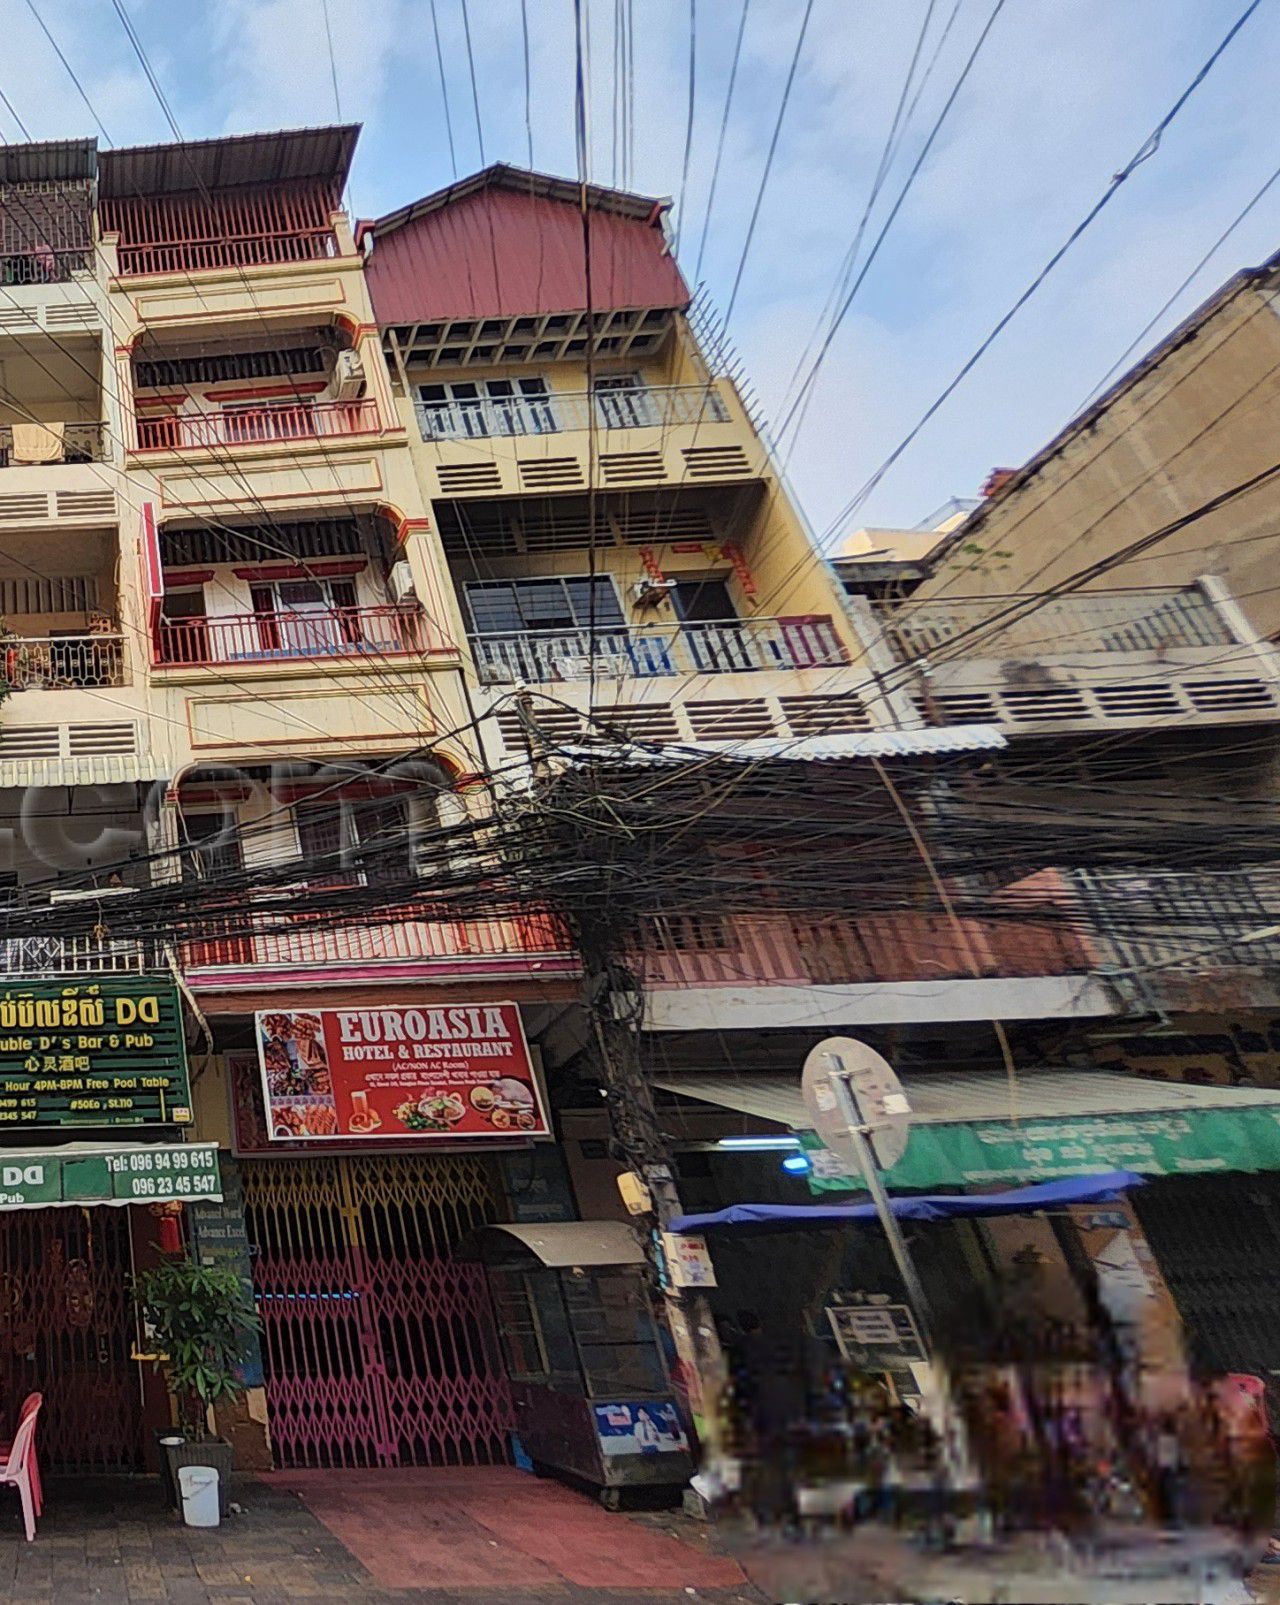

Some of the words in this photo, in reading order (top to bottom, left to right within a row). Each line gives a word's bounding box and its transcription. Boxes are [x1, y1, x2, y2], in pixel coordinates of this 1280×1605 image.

[336, 1008, 511, 1043] EUROASIA
[78, 1035, 102, 1049] Bar
[109, 1034, 120, 1048] &
[125, 1033, 154, 1048] Pub
[342, 1045, 394, 1061] HOTEL
[397, 1044, 411, 1060] &
[414, 1042, 513, 1059] RESTAURANT
[24, 1055, 90, 1073] 心灵酒吧
[5, 1081, 30, 1091] Hour
[33, 1079, 83, 1090] 4PM-8PM
[86, 1078, 109, 1089] Free
[113, 1078, 137, 1088] Pool
[141, 1076, 169, 1087] Table
[105, 1155, 129, 1172] Tel:
[130, 1154, 153, 1171] 096
[154, 1153, 171, 1169] 94
[172, 1152, 189, 1168] 99
[190, 1151, 213, 1167] 615
[132, 1177, 155, 1195] 096
[157, 1176, 174, 1194] 23
[175, 1175, 191, 1193] 45
[193, 1174, 216, 1192] 547
